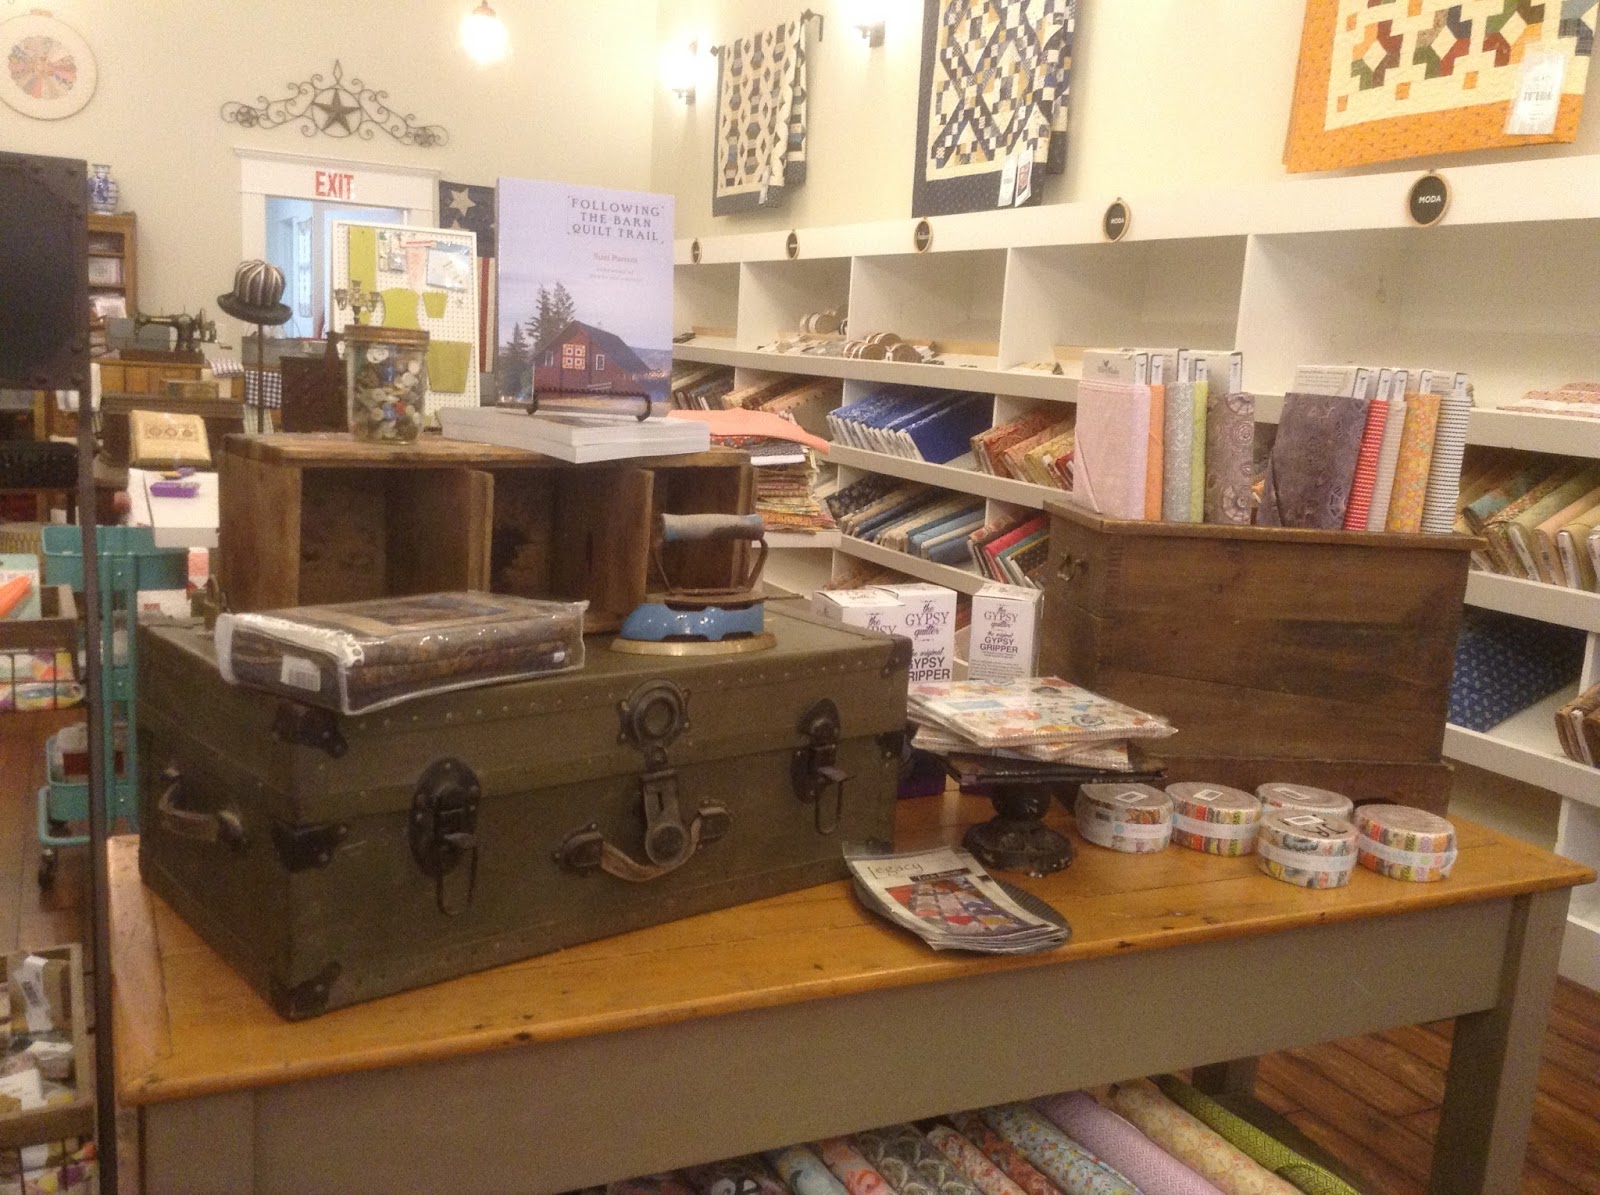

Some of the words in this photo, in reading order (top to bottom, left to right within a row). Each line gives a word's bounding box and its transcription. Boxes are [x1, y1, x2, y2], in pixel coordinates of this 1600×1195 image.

[315, 171, 354, 199] EXIT
[1418, 195, 1441, 204] MODA
[572, 198, 660, 216] FOLLOWING
[580, 212, 606, 224] THE
[614, 215, 651, 228] BARN
[572, 224, 611, 237] QUILT
[619, 228, 658, 240] TRAIL
[923, 603, 934, 613] the
[868, 615, 881, 626] the
[905, 611, 949, 627] GYPSY
[984, 611, 1018, 622] GYPSY
[914, 623, 940, 641] quilter
[984, 635, 1015, 646] GYPSY
[980, 643, 1018, 653] GRIPPER
[909, 656, 945, 669] YPSY
[908, 668, 951, 682] RIPPER
[867, 862, 924, 880] Legacy
